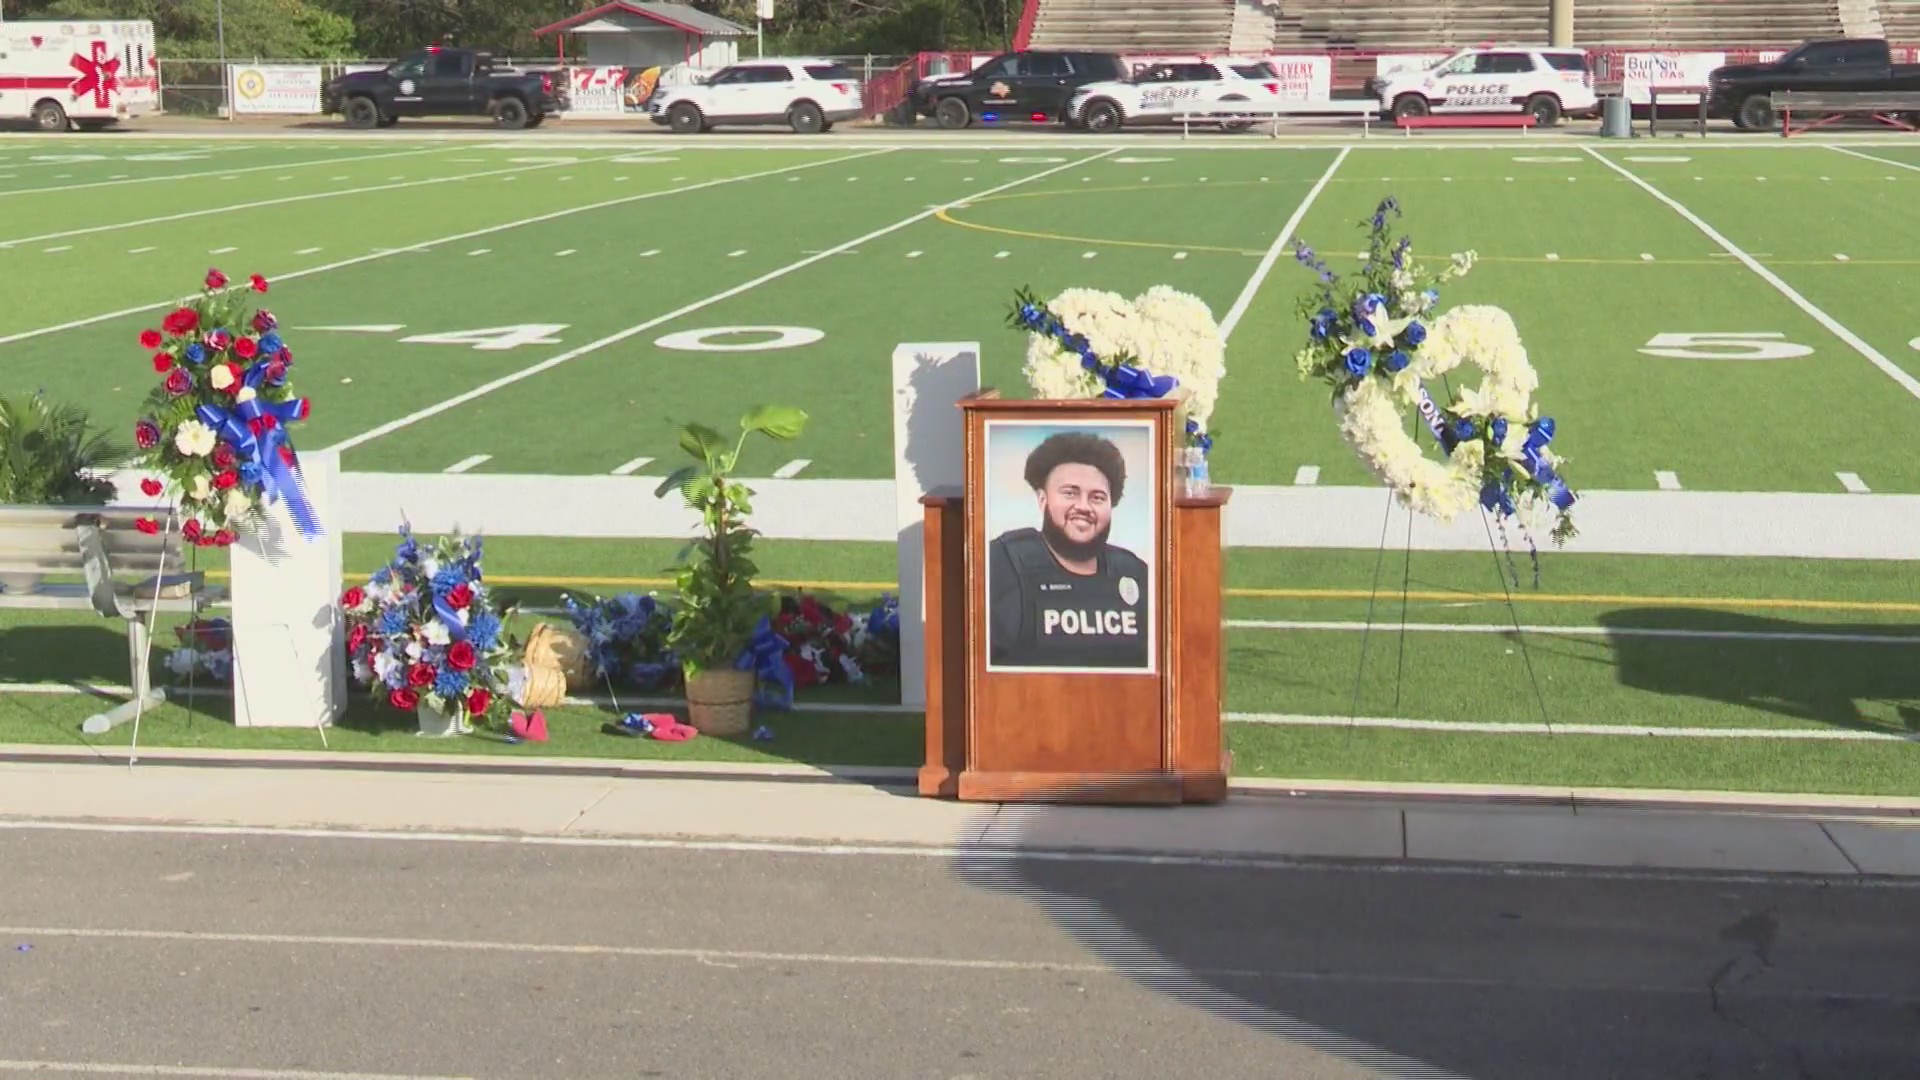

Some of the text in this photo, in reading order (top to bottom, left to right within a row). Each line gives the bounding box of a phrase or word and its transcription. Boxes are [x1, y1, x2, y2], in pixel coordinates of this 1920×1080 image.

[1628, 57, 1678, 70] Buron
[1446, 84, 1509, 95] POLICE
[398, 323, 571, 350] 4
[1635, 332, 1815, 360] 5
[1043, 609, 1139, 635] POLICE
